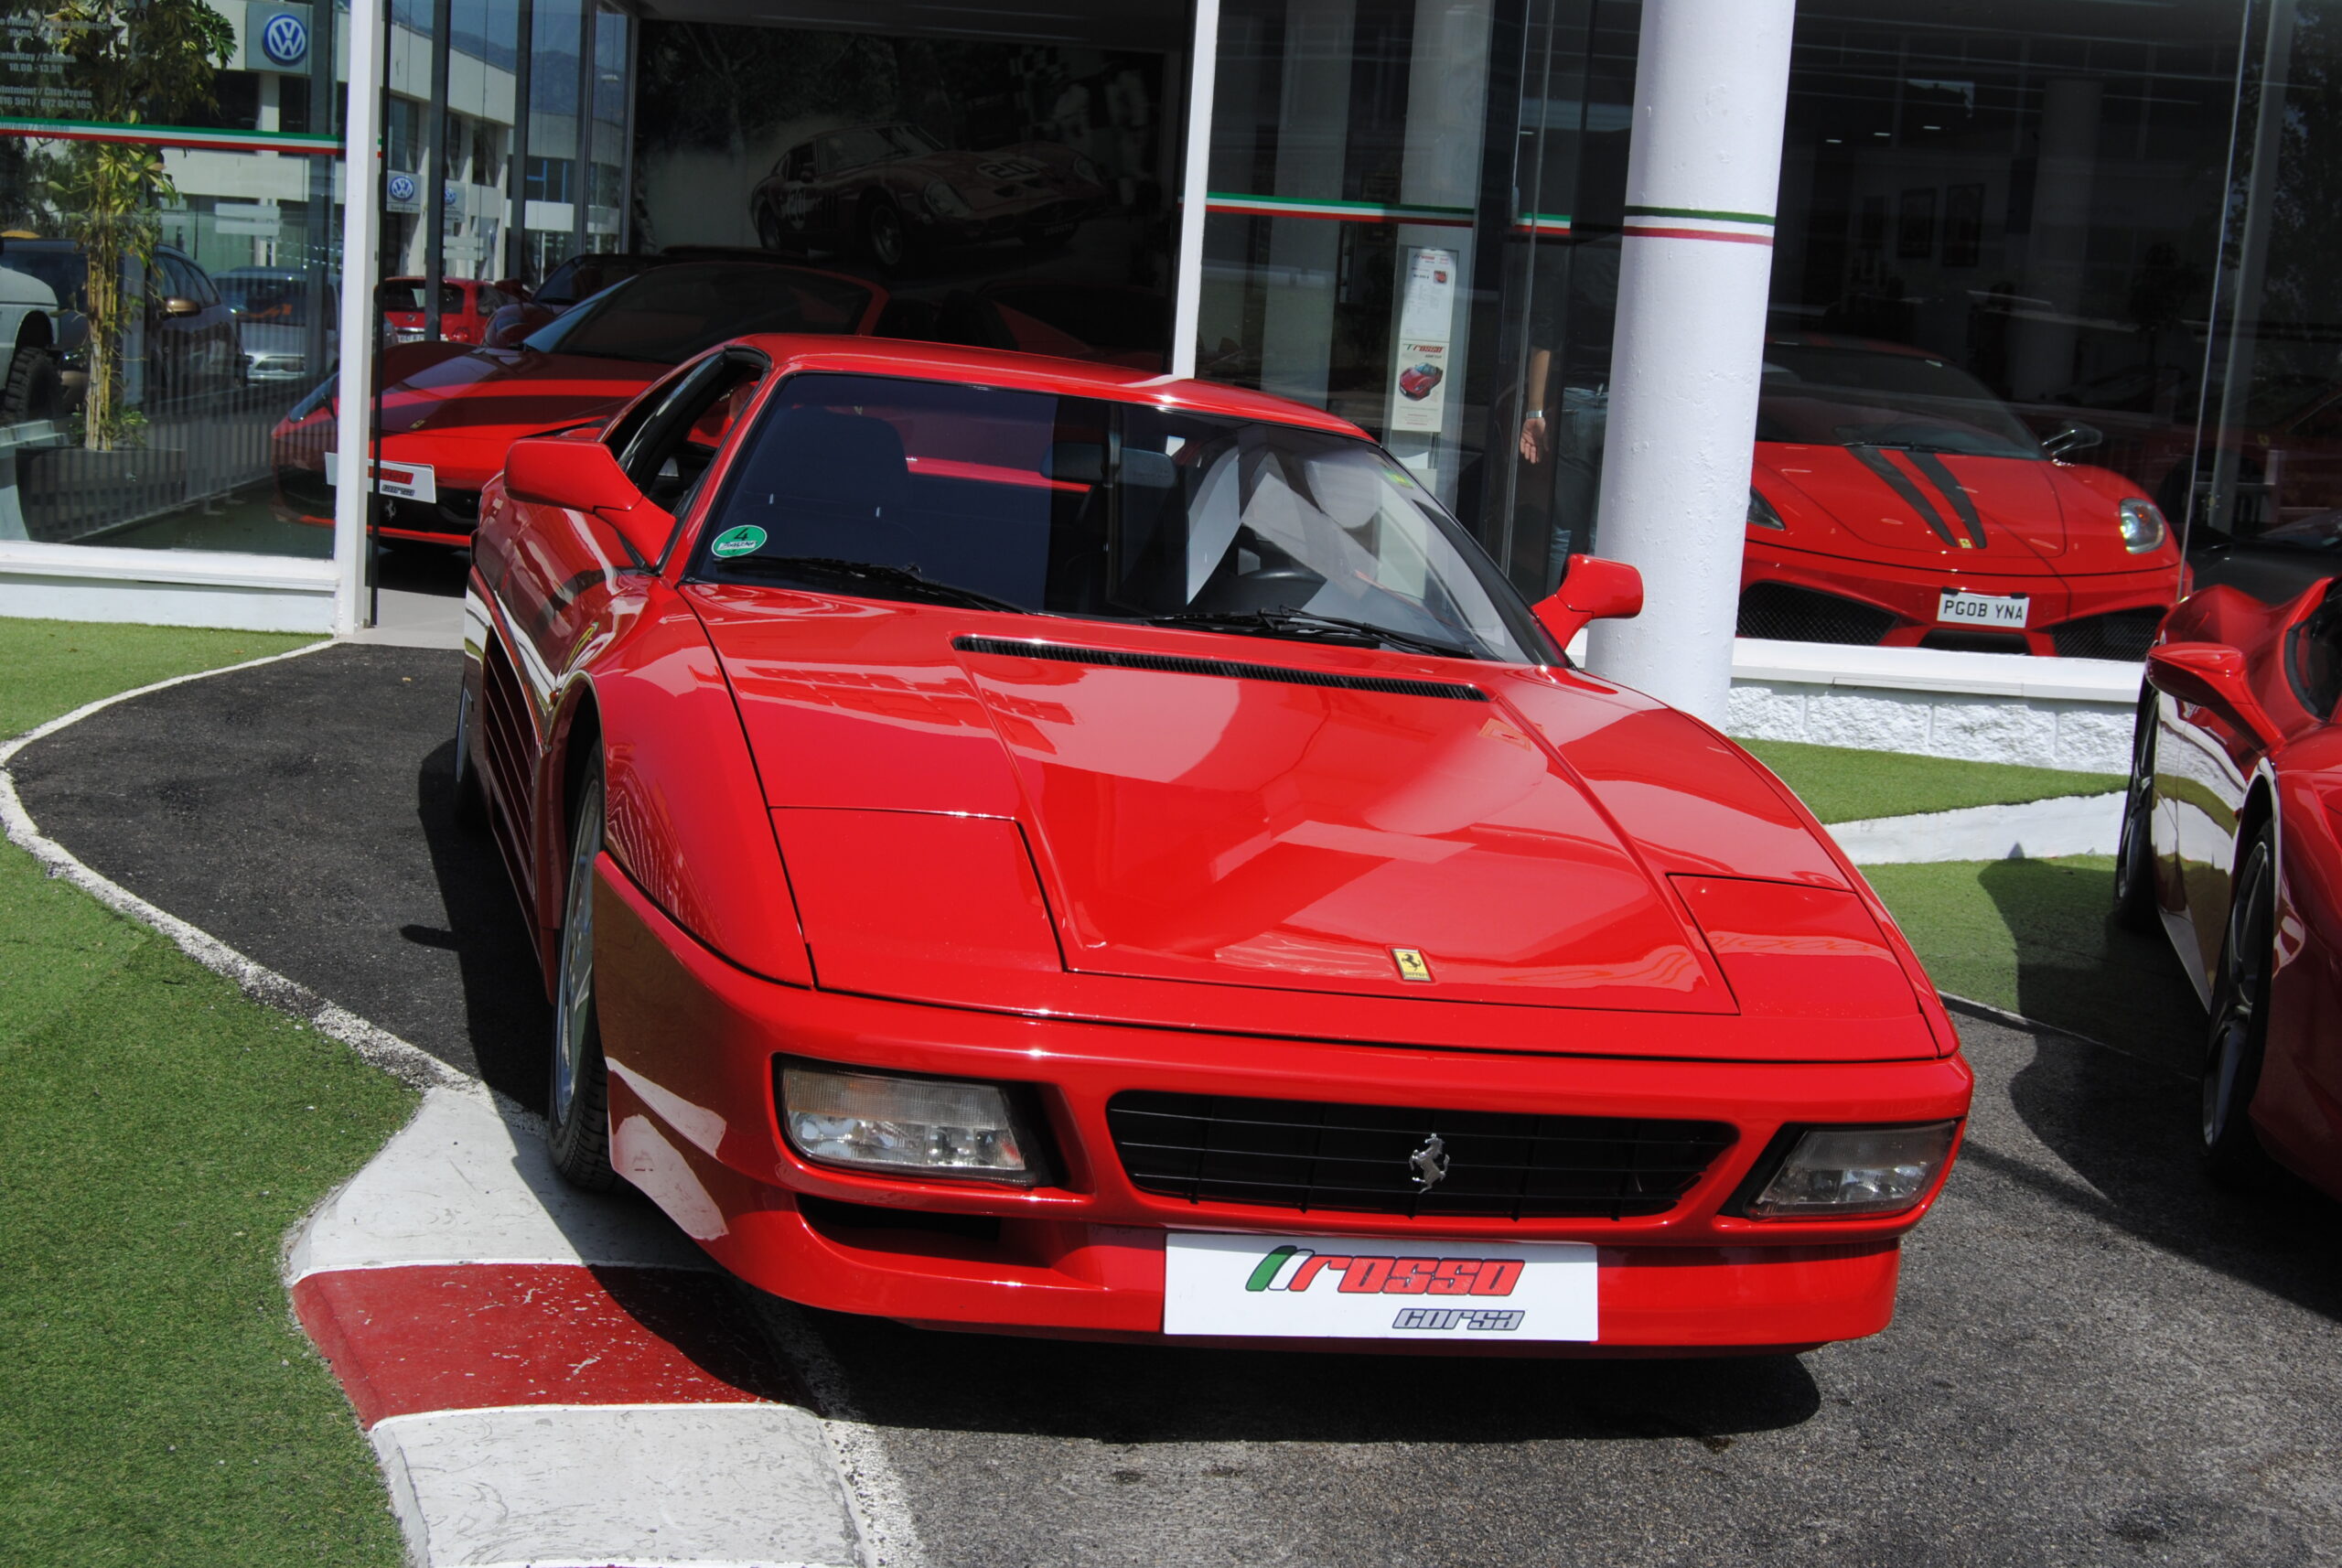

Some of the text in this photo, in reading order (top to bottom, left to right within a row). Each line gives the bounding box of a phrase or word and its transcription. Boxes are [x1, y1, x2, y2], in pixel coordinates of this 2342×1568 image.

[734, 527, 749, 542] 4
[1995, 604, 2024, 620] YNA
[1288, 1253, 1526, 1296] rosso
[1391, 1307, 1526, 1331] corsa
